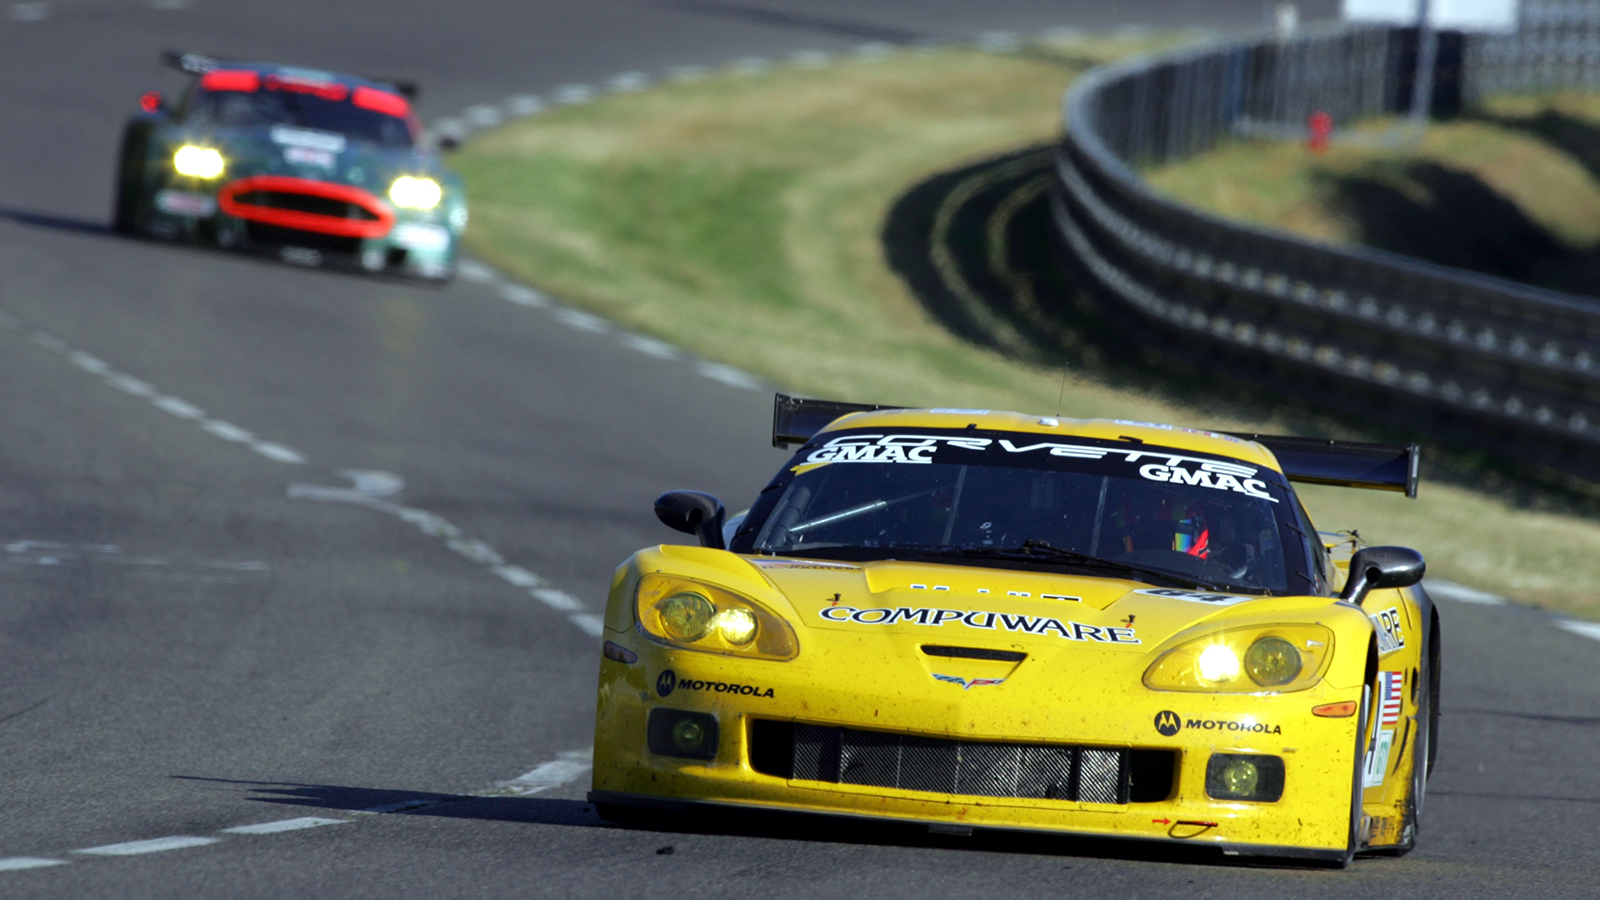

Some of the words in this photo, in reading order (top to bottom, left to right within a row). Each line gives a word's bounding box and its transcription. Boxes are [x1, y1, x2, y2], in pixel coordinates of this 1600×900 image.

[806, 445, 937, 462] GMAC
[823, 434, 1258, 478] CORVETTE
[1139, 464, 1271, 498] GMAC
[819, 606, 1142, 644] COMPUWARE
[678, 679, 775, 698] MOTOROLA
[1186, 719, 1282, 735] MOTOROLA
